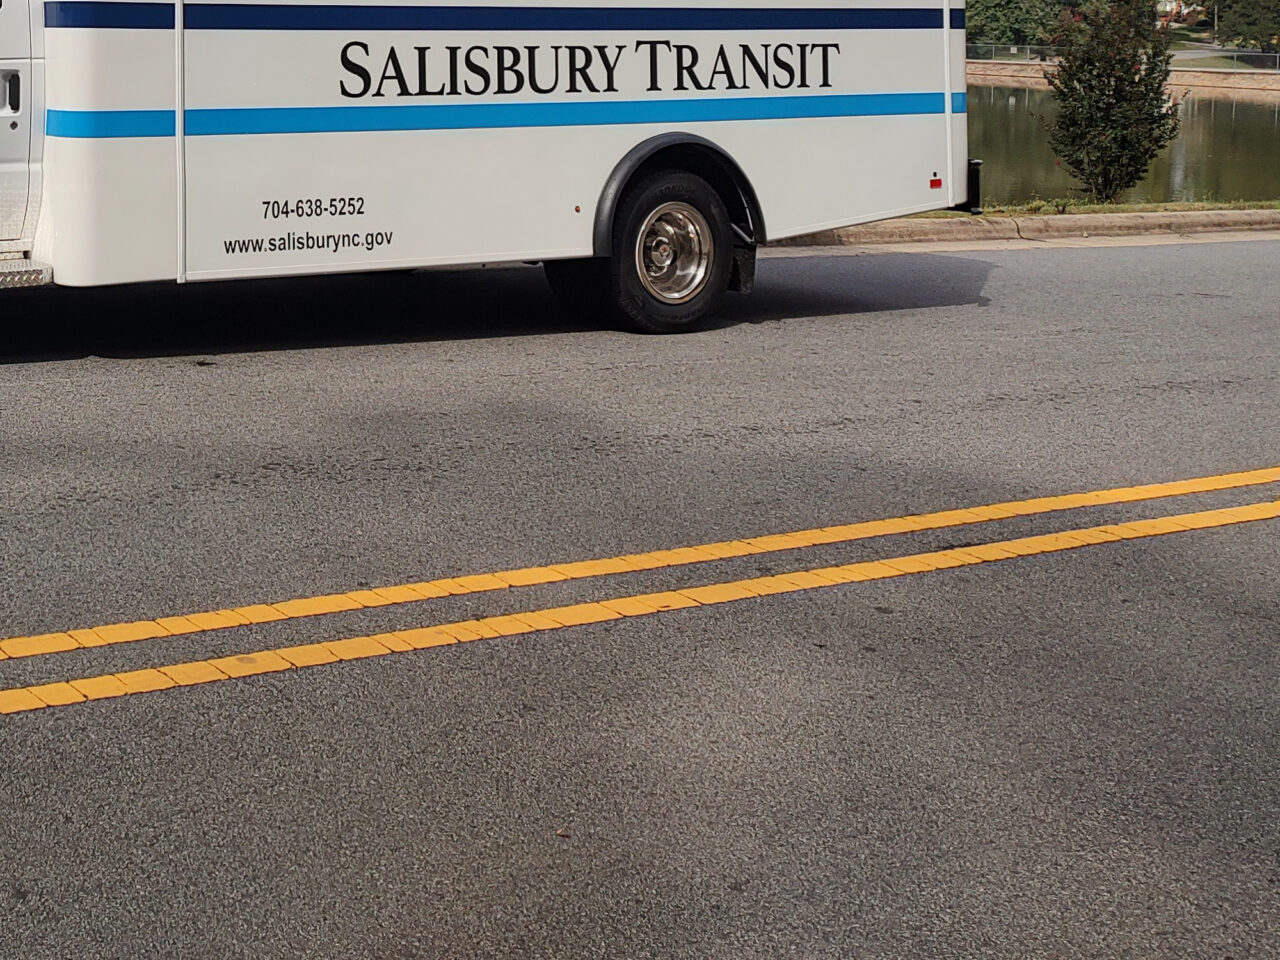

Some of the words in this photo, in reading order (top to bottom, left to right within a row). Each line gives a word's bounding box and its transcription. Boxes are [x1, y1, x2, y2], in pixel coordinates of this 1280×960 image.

[339, 39, 628, 99] SALISBURY
[634, 38, 840, 92] TRANSIT
[261, 196, 366, 220] 704-638-5252
[223, 230, 394, 255] www.salisburync.gov
